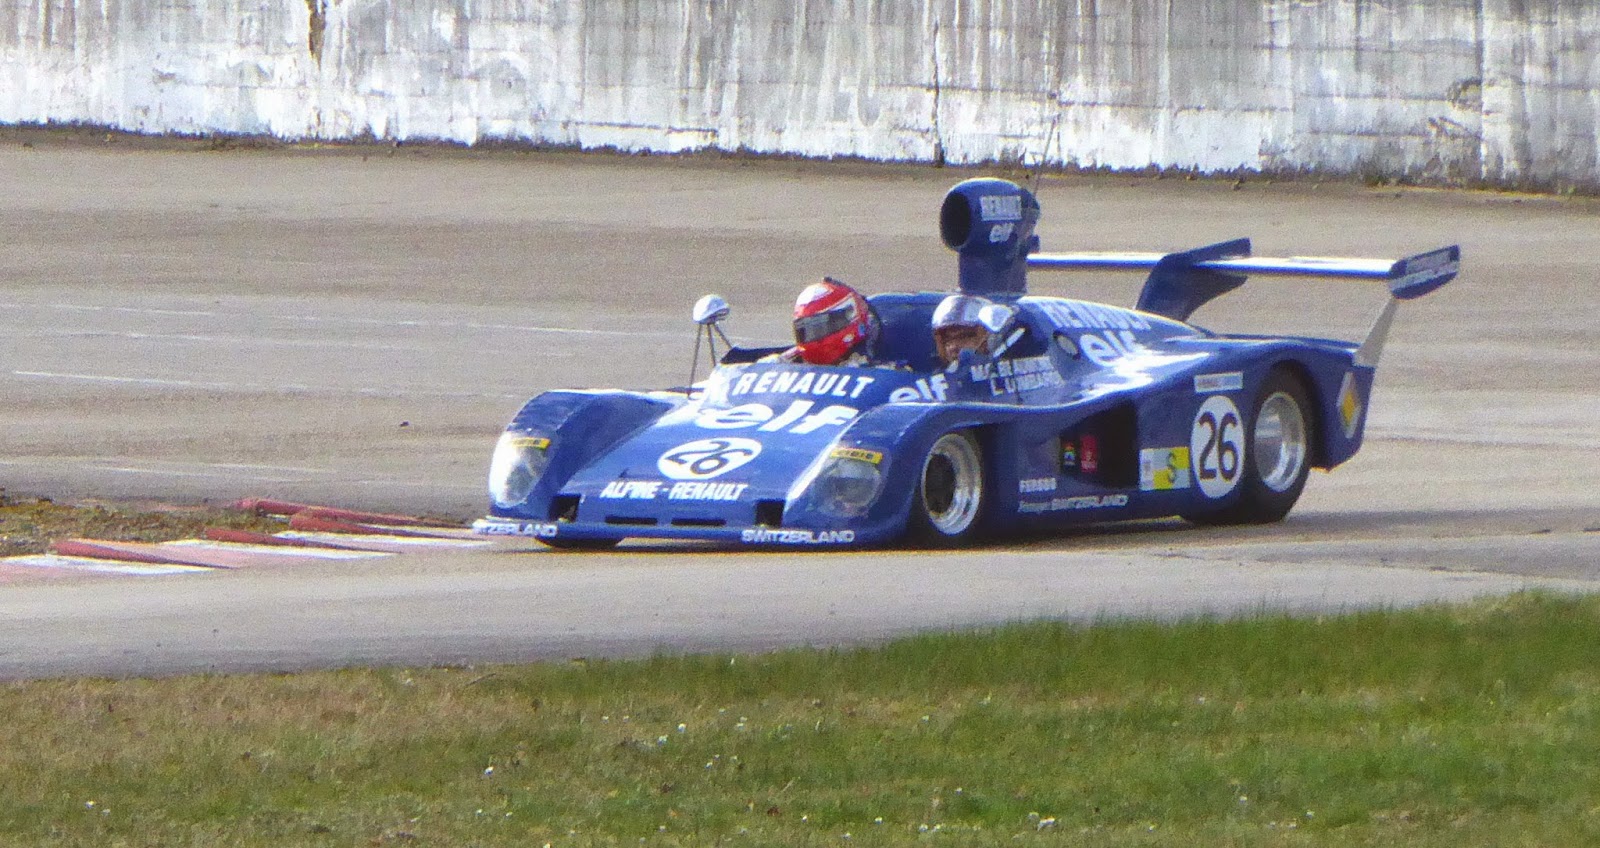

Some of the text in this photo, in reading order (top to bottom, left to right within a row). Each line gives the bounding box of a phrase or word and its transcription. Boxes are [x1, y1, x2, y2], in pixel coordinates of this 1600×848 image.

[732, 371, 875, 399] RENAULT
[889, 373, 950, 403] elf
[694, 400, 859, 434] elf
[665, 440, 754, 475] 26
[1198, 411, 1239, 482] 26
[600, 481, 663, 499] ALPINE
[668, 482, 749, 501] RENAULT
[741, 528, 855, 545] SWITZERLAND
